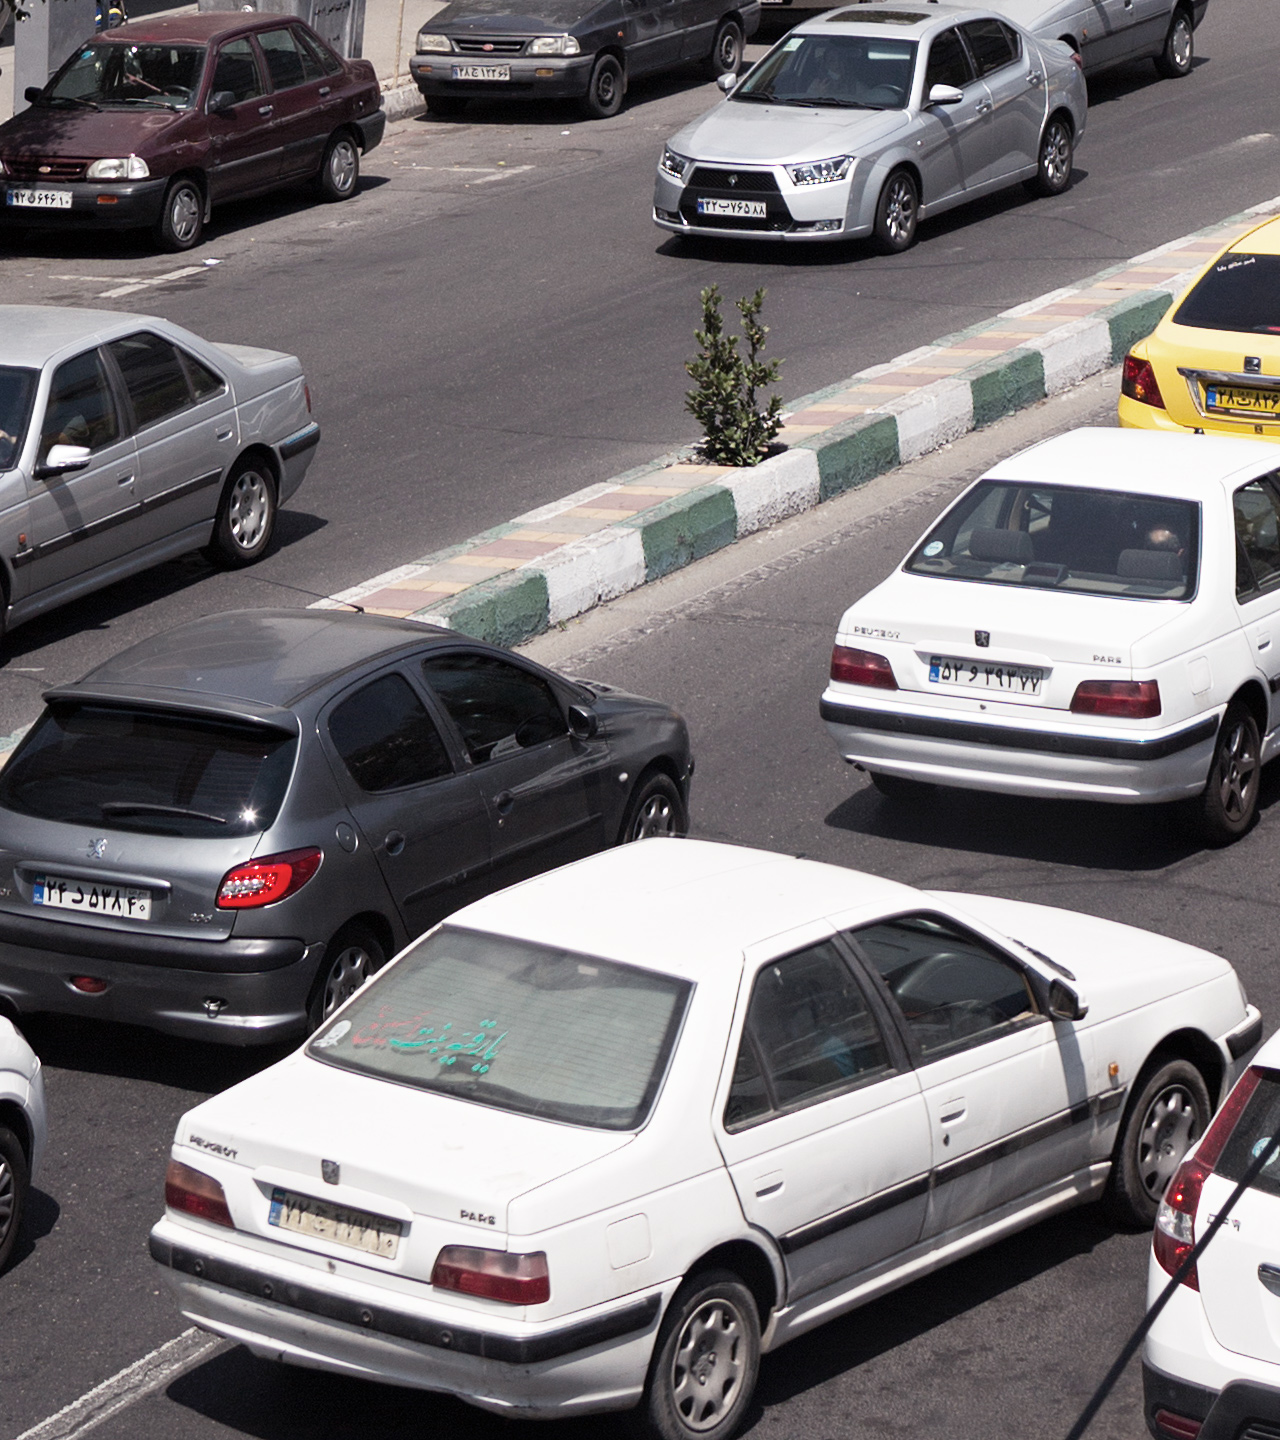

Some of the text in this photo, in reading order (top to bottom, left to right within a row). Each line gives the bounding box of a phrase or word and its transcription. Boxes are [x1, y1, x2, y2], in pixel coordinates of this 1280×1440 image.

[1093, 654, 1122, 664] PARS
[190, 1135, 238, 1160] PEUGEOT
[460, 1209, 497, 1225] PARS
